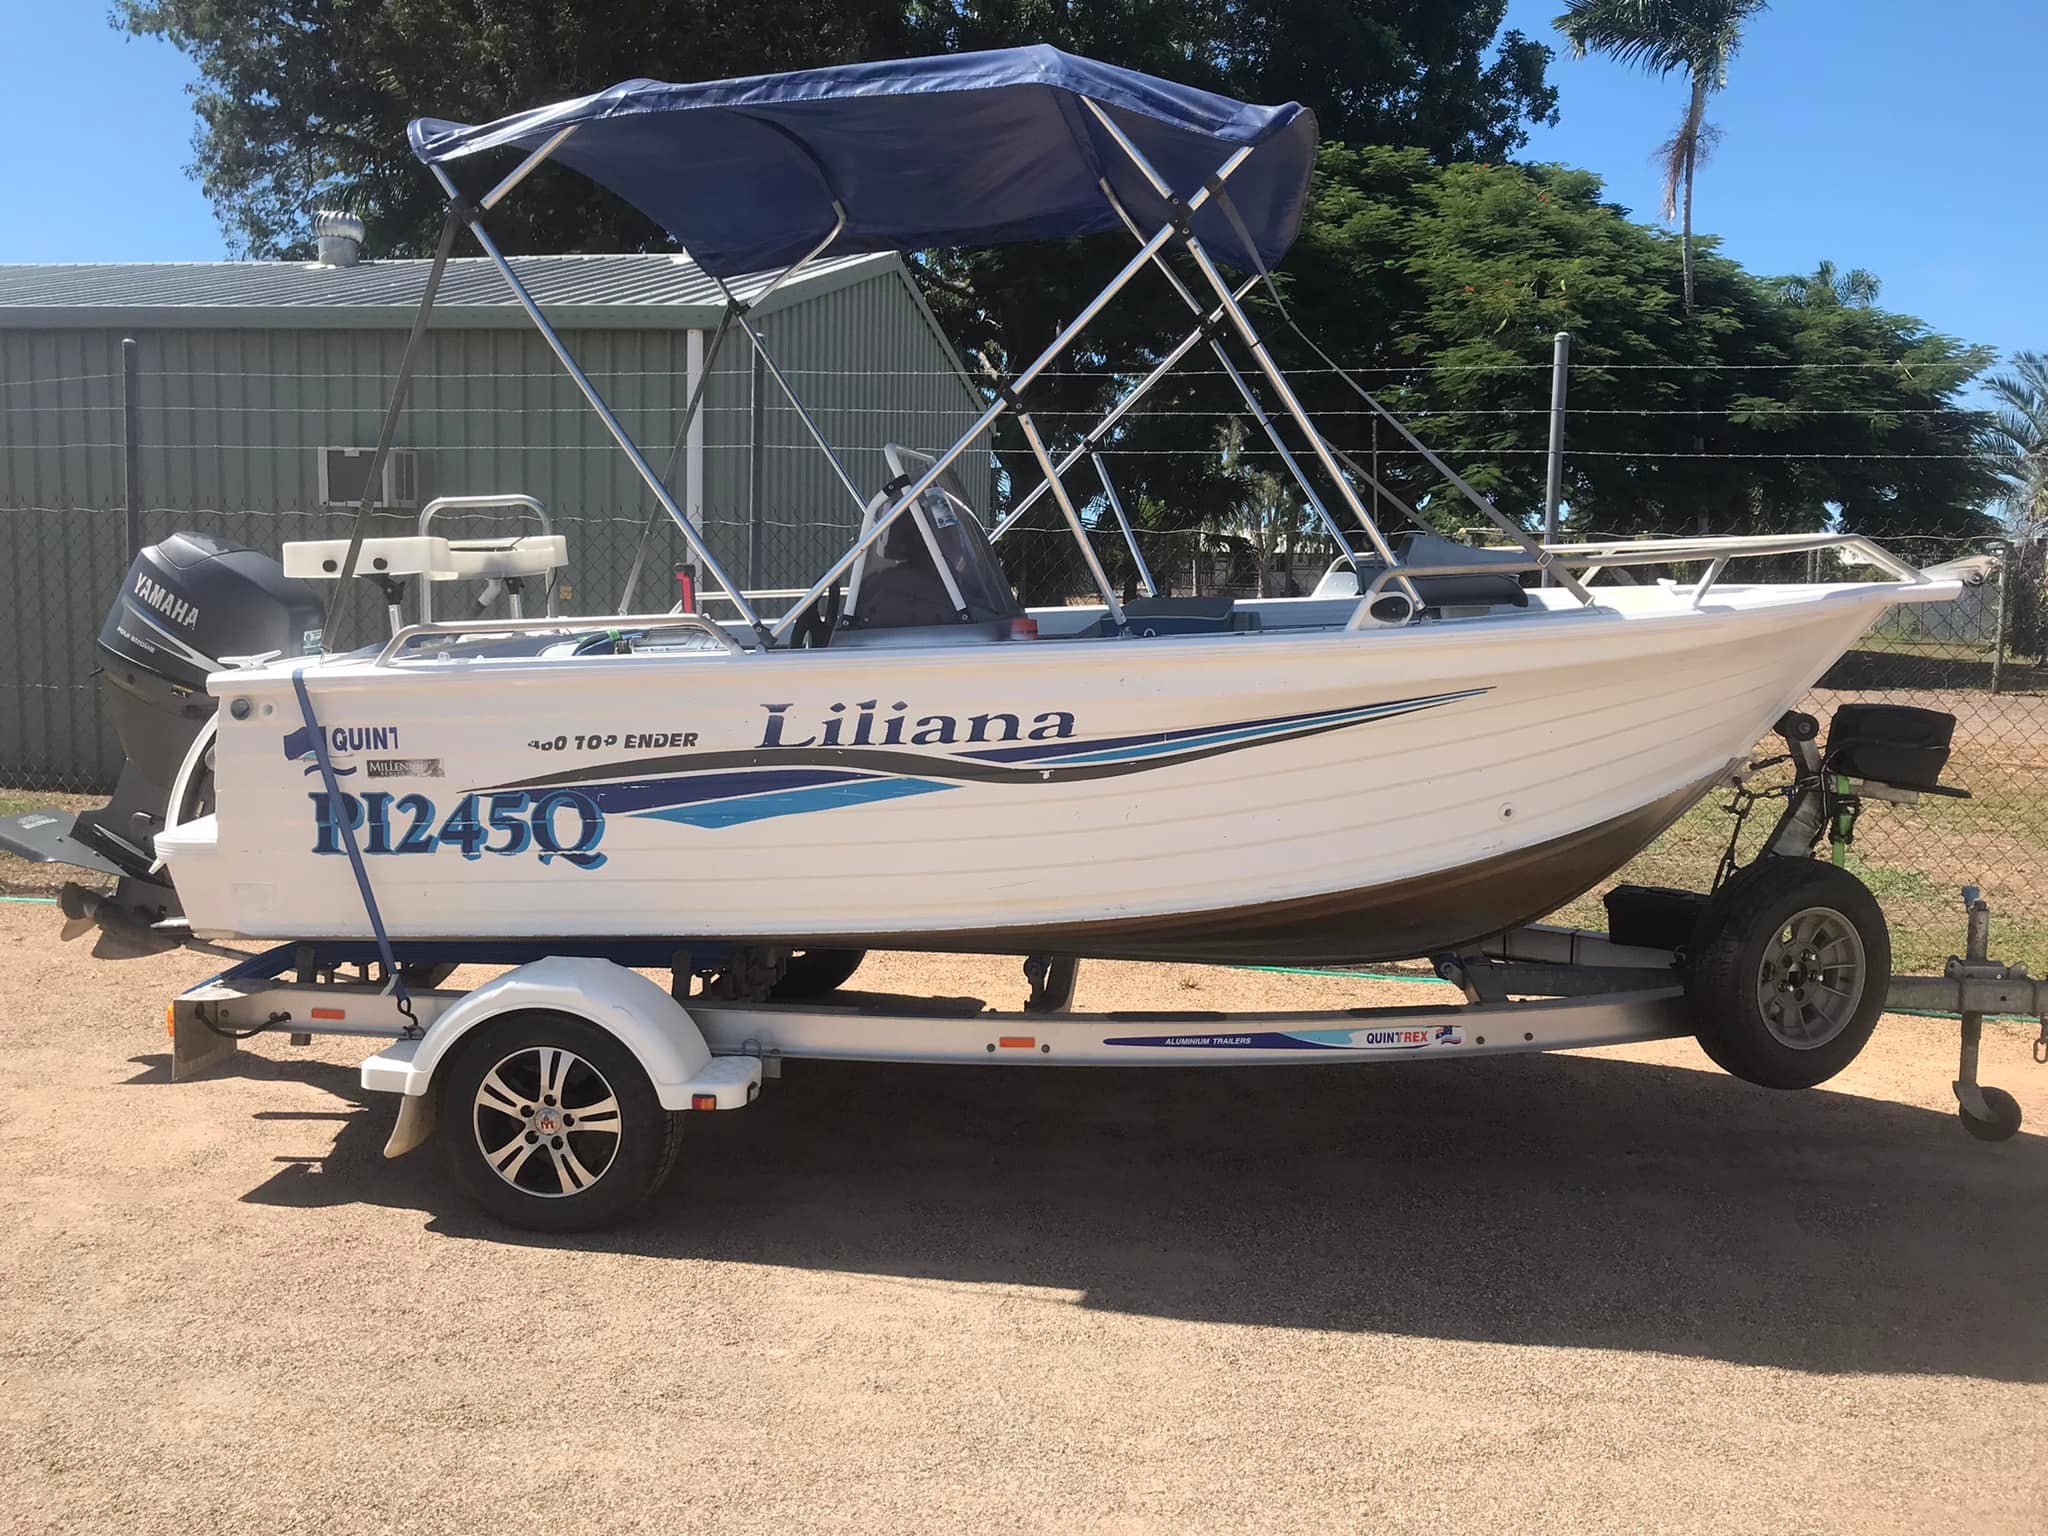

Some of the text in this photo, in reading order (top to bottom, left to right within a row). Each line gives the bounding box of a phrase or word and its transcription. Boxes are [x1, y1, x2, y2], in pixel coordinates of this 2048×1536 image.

[134, 572, 200, 630] YAMAHA
[754, 699, 1077, 748] Liliana
[575, 735, 617, 750] TOP
[624, 733, 698, 749] ENDER
[308, 790, 608, 870] PI245Q
[1165, 1037, 1252, 1046] ALUMINIUM TRAILERS
[1366, 1031, 1429, 1044] QUINTREX
